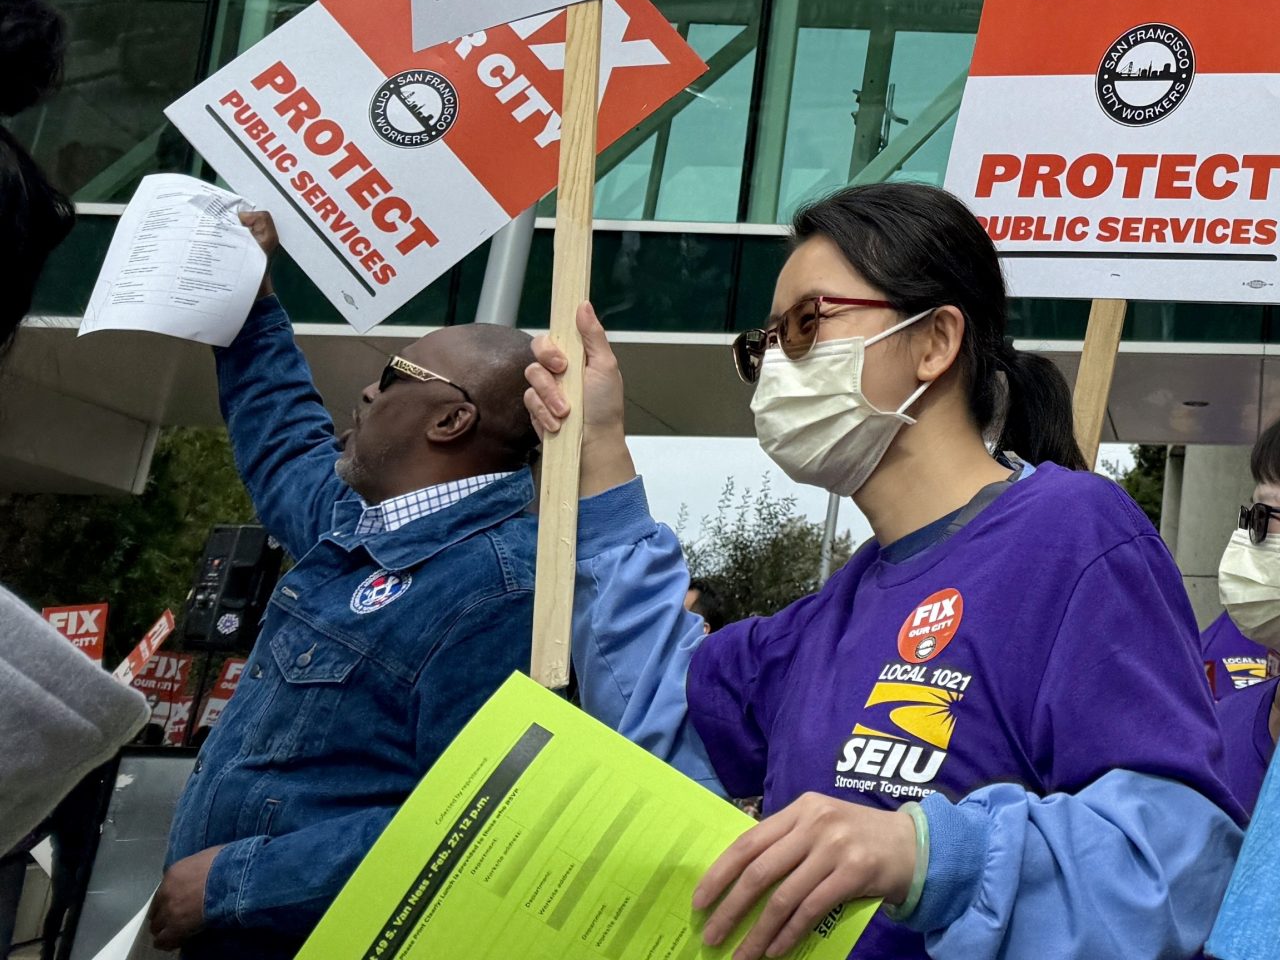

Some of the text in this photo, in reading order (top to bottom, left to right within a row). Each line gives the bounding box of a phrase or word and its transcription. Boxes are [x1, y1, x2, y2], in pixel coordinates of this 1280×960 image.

[1105, 29, 1189, 69] SAN FRANCISCO
[375, 91, 429, 143] CITY WORKERS
[398, 74, 454, 130] SAN FRANCISCO
[475, 54, 564, 149] CITY
[1103, 83, 1185, 120] CITY WORKERS
[250, 60, 439, 257] PROTECT
[219, 89, 397, 286] PUBLIC SERVICES
[1096, 216, 1277, 246] SERVICES
[49, 609, 101, 635] FIX
[912, 594, 958, 626] FIX
[909, 626, 930, 637] OUR
[134, 679, 156, 688] OUR
[141, 656, 186, 679] FIX
[879, 664, 972, 691] LOCAL 1021
[836, 738, 947, 783] SEIU
[835, 775, 876, 792] Stronger
[375, 939, 387, 954] 49
[385, 929, 396, 939] S.
[392, 905, 411, 925] Van
[408, 879, 429, 904] Ness
[430, 849, 450, 871] Feb.
[447, 832, 463, 847] 27,
[459, 818, 471, 829] 12
[469, 796, 489, 818] p.m.
[412, 923, 426, 939] Print
[439, 879, 455, 898] Lunch
[457, 844, 478, 873] provided
[482, 819, 496, 836] those
[495, 805, 506, 818] who
[818, 904, 842, 938] SEIU
